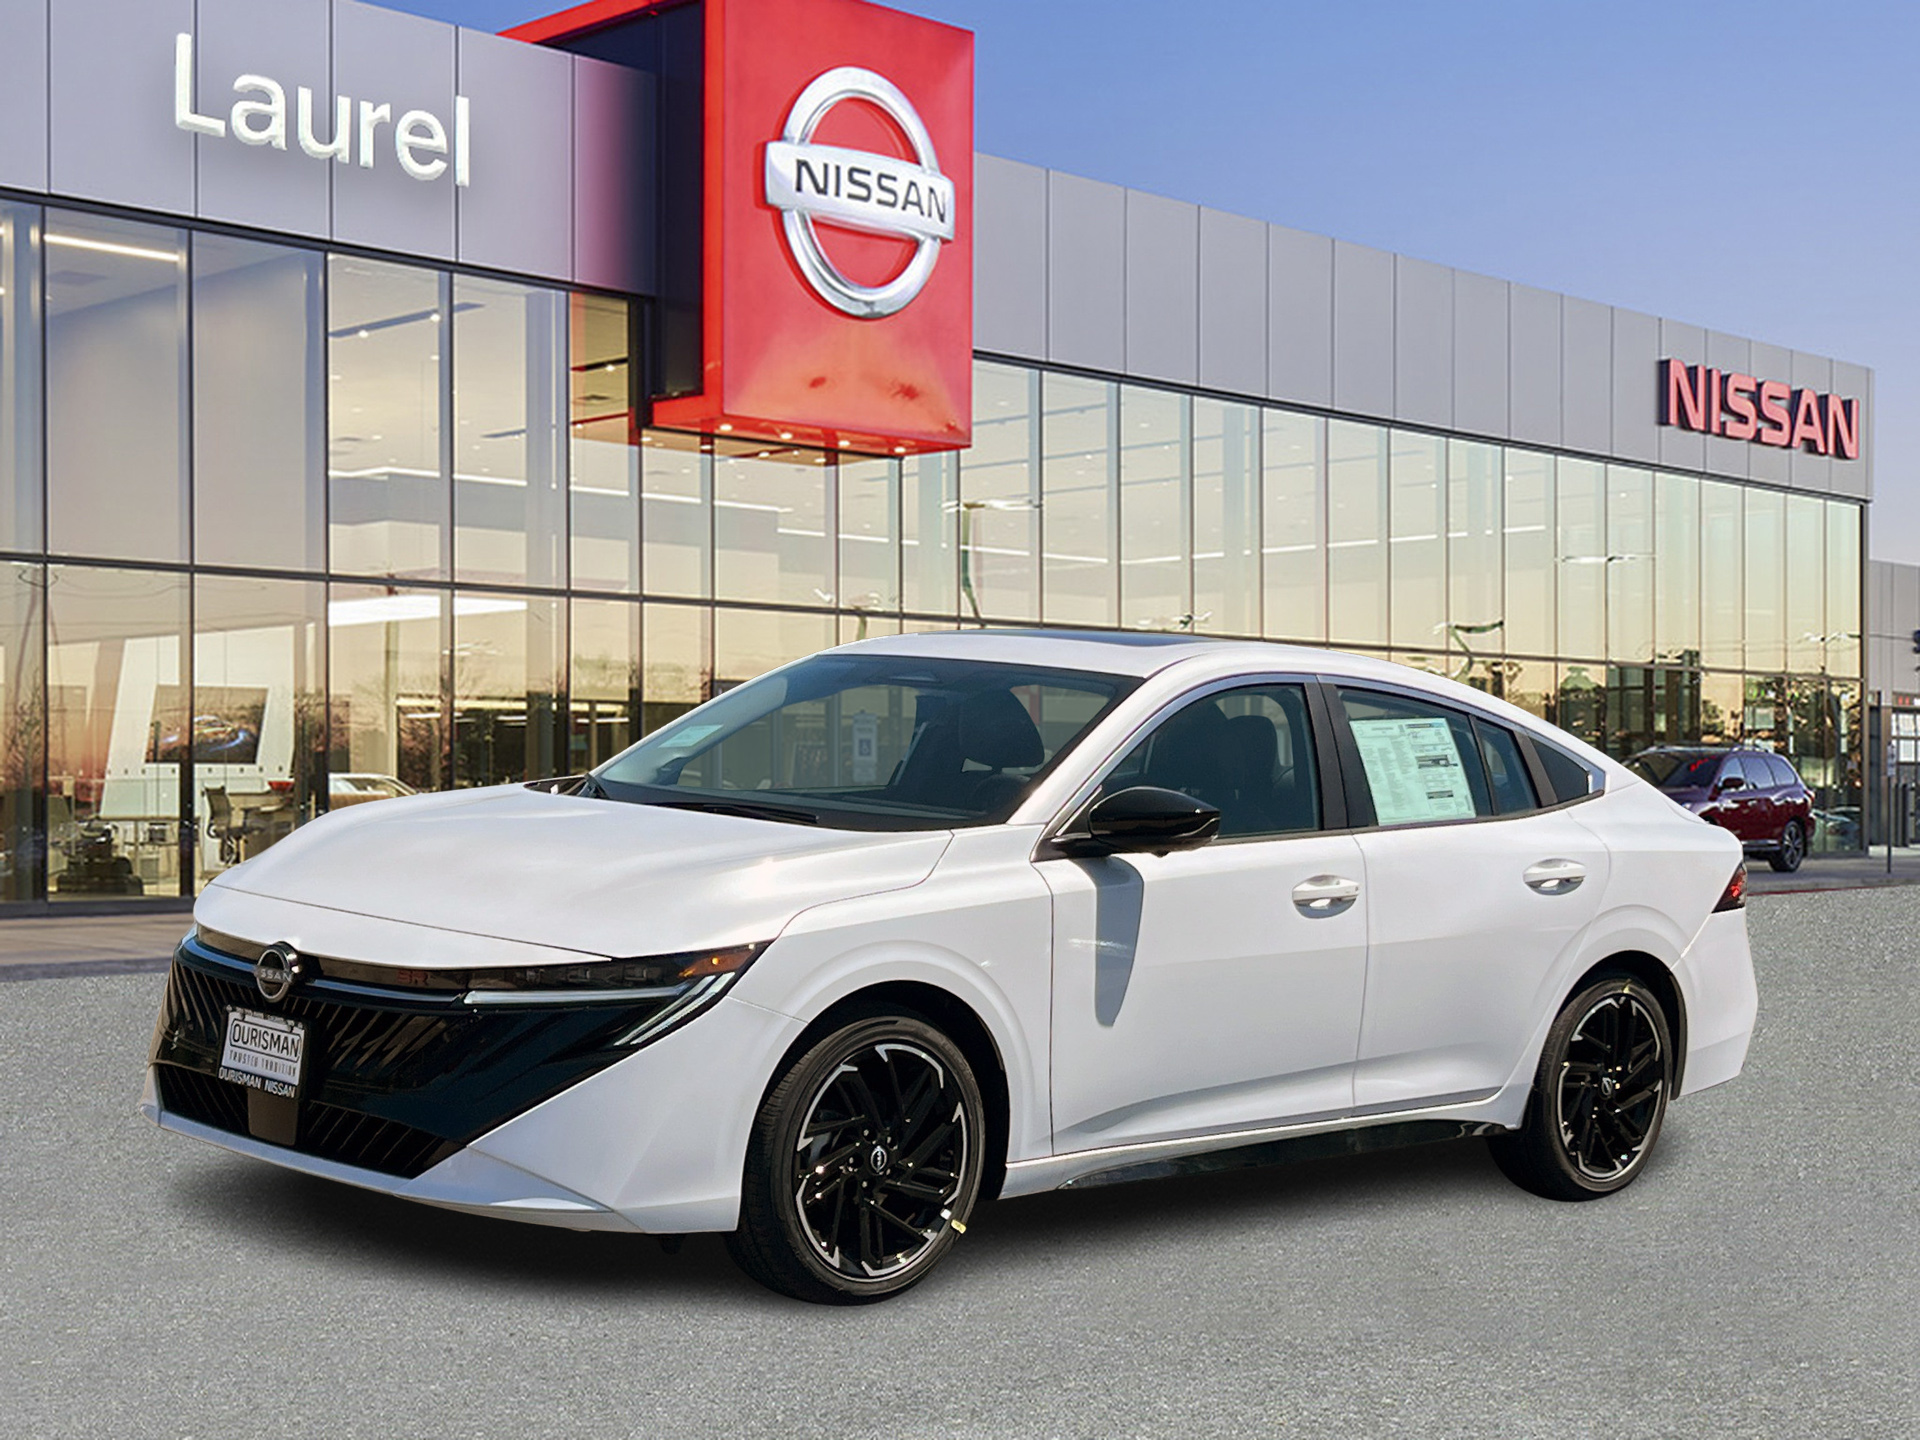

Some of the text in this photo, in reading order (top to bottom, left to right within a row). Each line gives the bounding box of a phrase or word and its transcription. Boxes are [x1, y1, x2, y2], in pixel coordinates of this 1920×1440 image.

[175, 33, 470, 187] Laurel
[795, 158, 947, 224] NISSAN
[1658, 358, 1860, 460] NISSAN
[232, 1023, 300, 1058] OURISMAN
[218, 1066, 297, 1098] OURISMAN NISSAN
